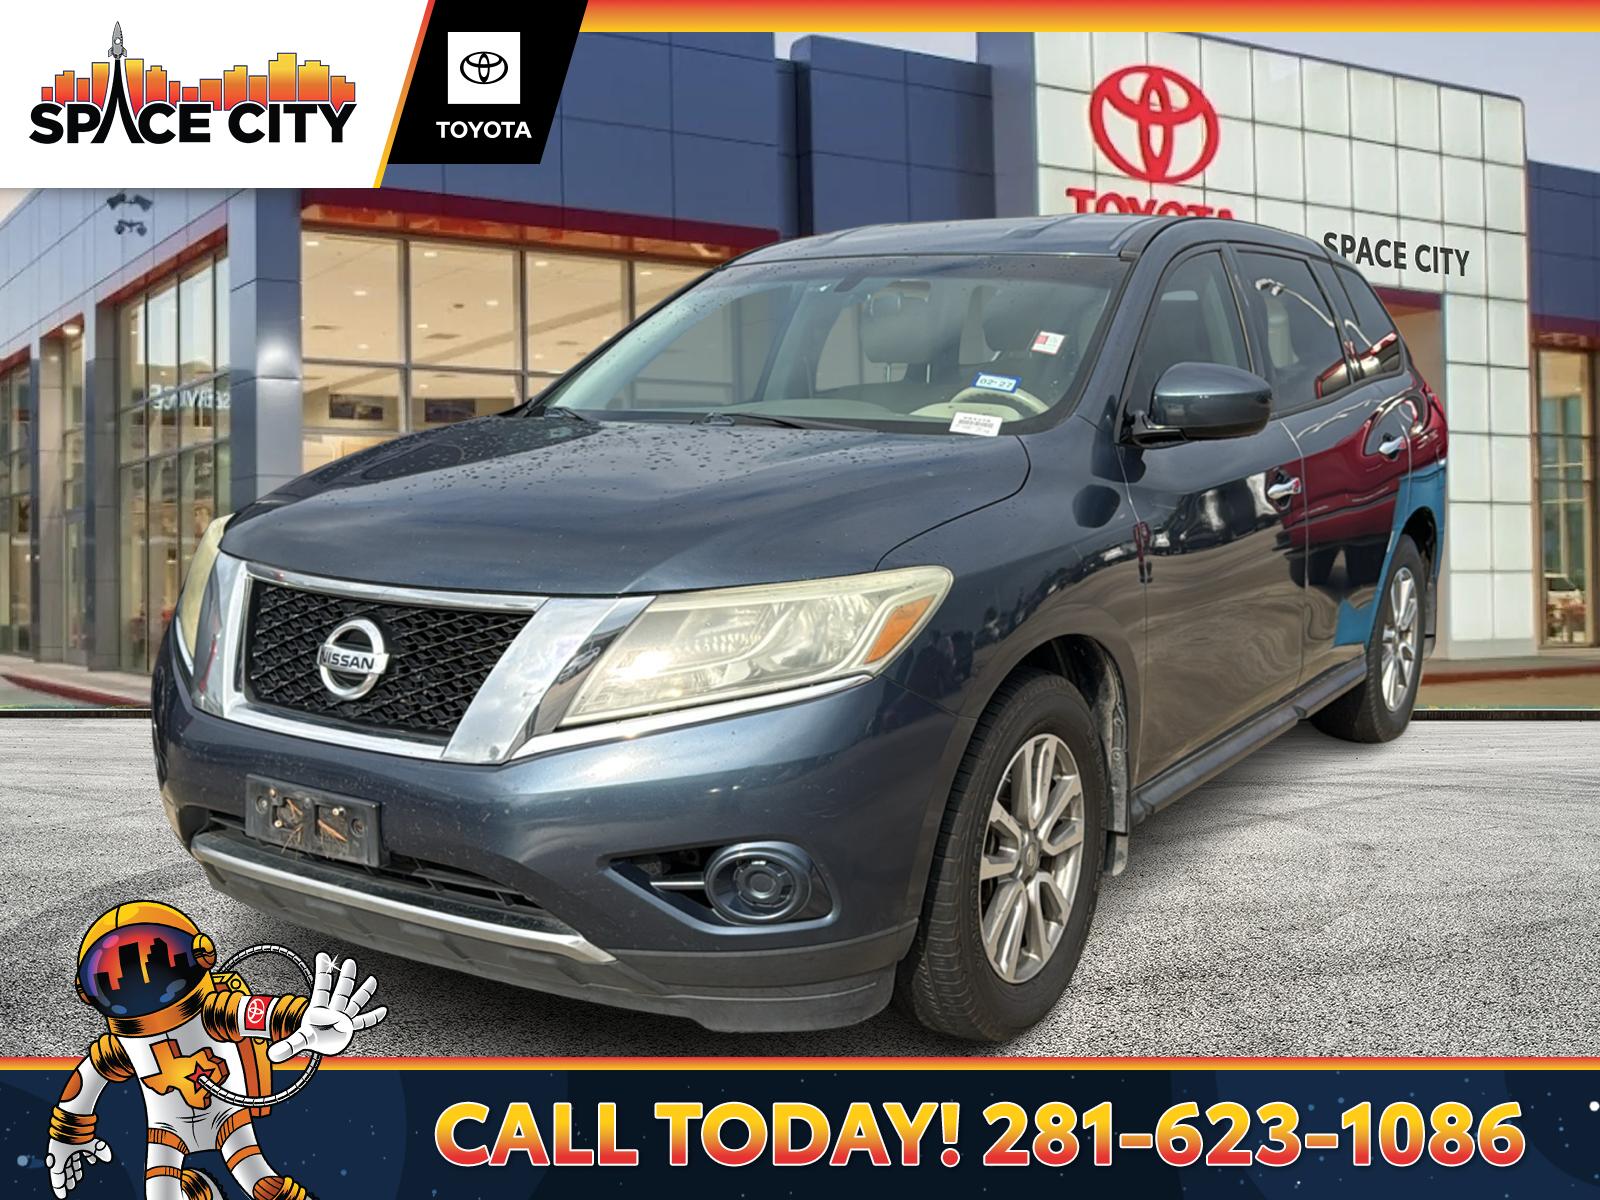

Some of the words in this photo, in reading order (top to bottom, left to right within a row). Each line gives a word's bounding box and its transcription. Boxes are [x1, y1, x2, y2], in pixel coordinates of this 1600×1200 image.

[1066, 188, 1233, 220] TOY
[1323, 232, 1407, 270] SPACE
[1415, 244, 1470, 277] CITY
[321, 650, 374, 670] NISSAN
